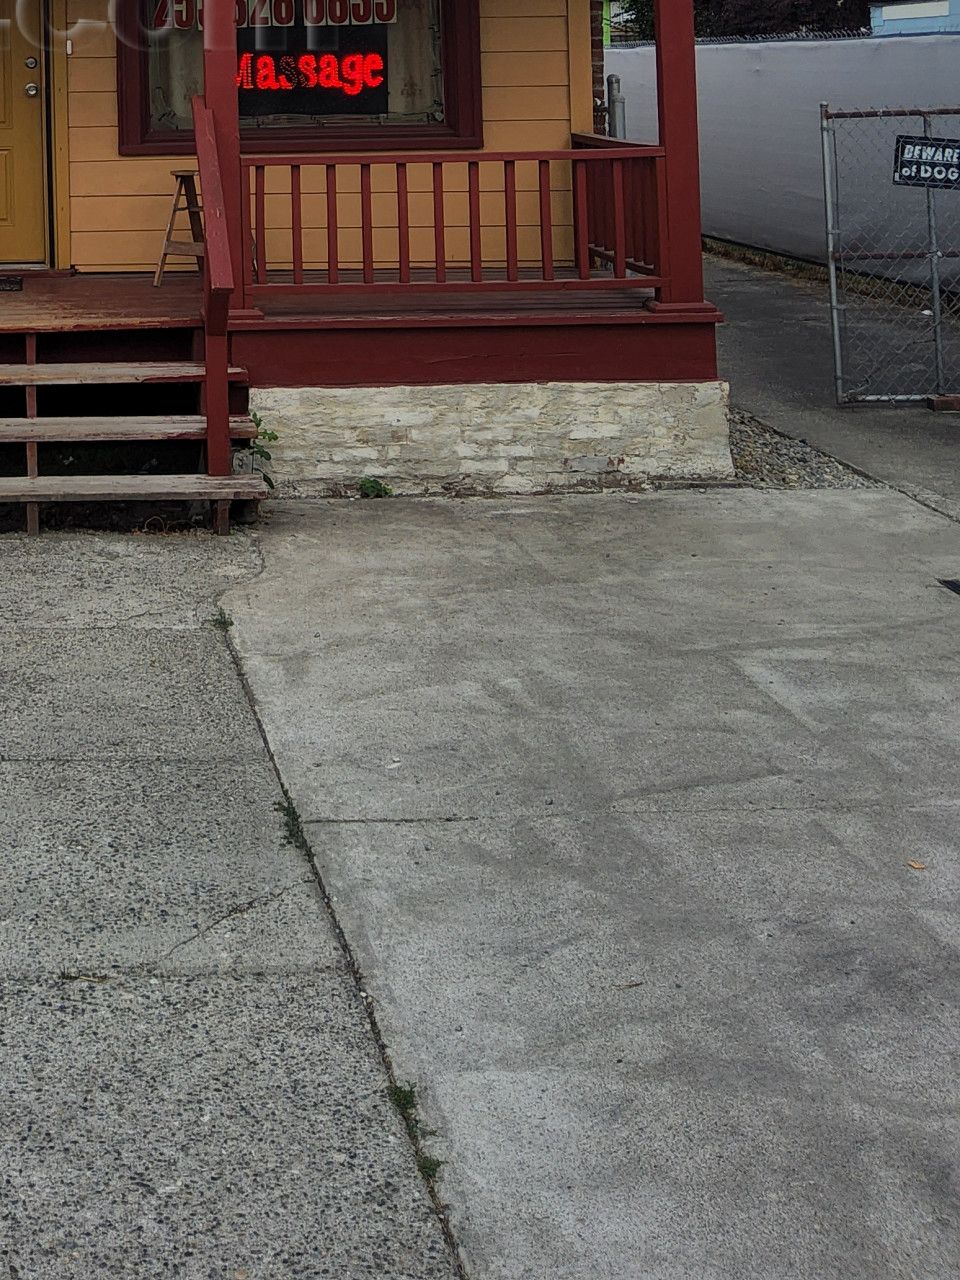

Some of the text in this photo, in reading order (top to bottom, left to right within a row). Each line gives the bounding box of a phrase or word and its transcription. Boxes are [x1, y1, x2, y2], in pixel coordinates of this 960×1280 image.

[902, 144, 960, 162] BEWARE
[901, 165, 960, 180] of DOG
